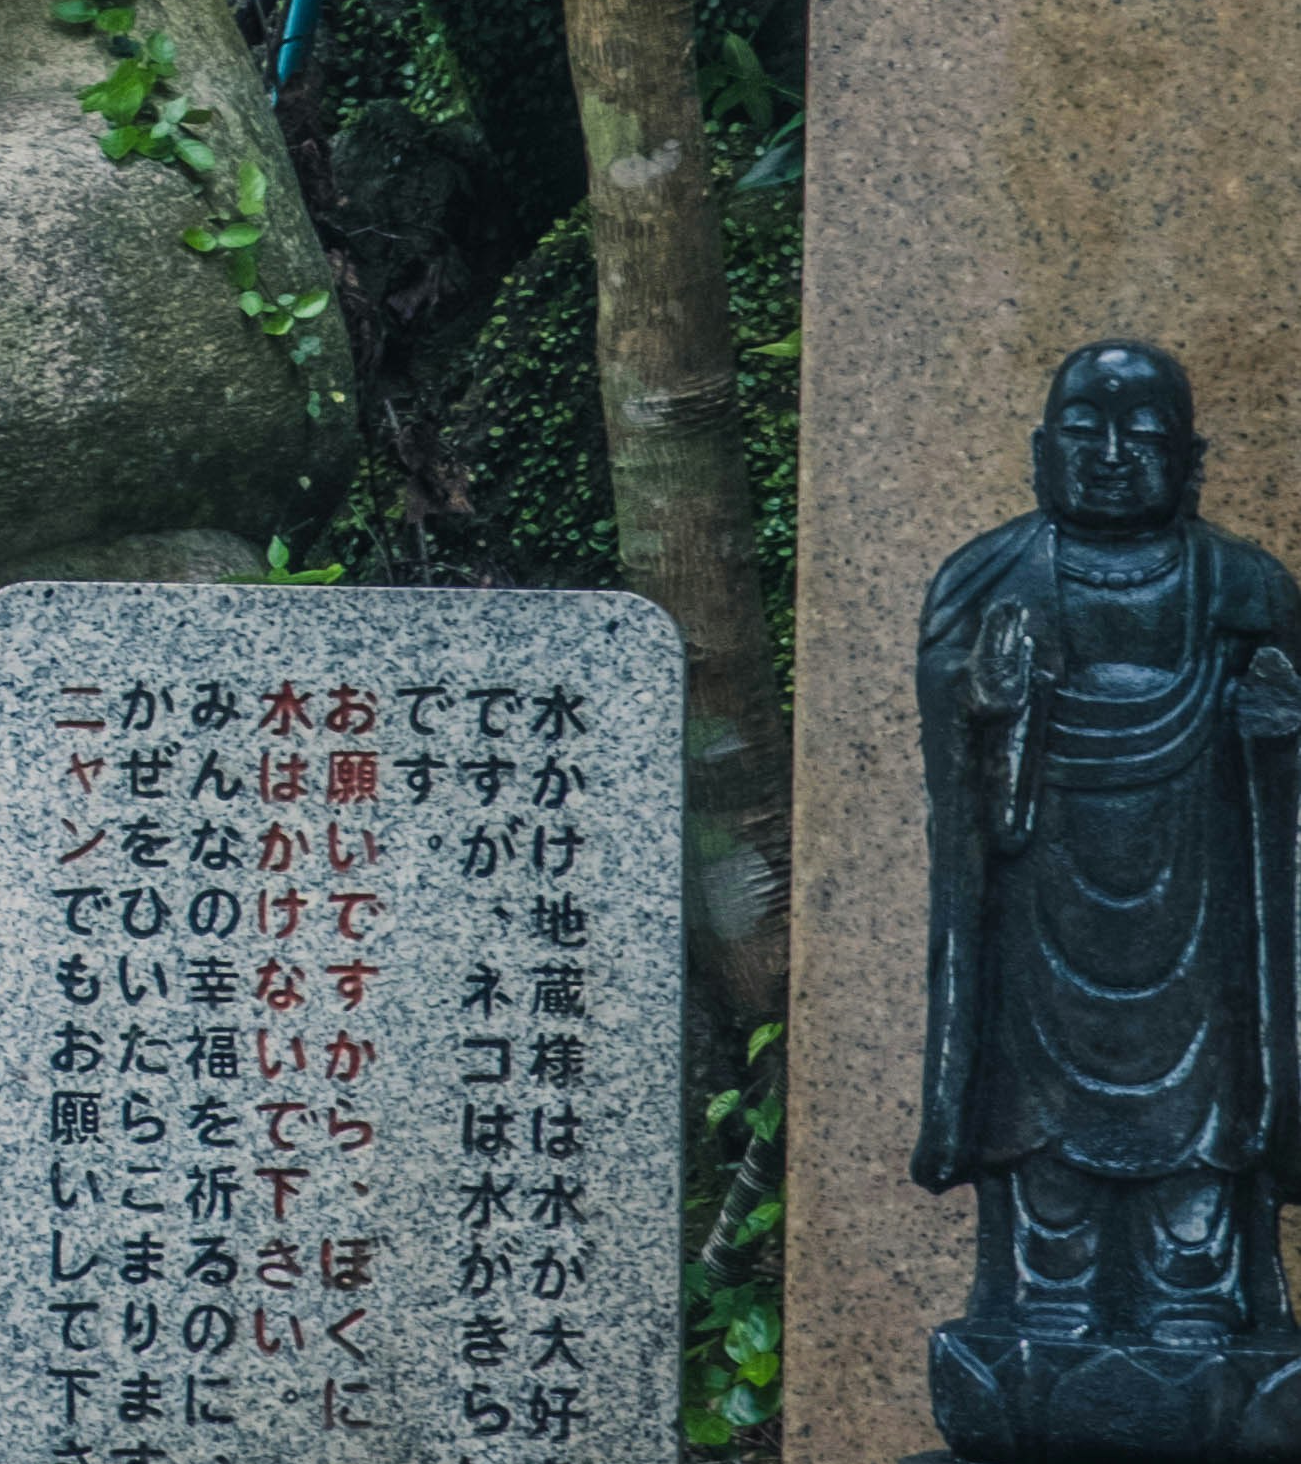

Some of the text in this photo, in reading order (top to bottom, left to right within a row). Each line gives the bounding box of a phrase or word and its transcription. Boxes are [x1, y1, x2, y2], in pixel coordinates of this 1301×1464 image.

[253, 680, 317, 1404] 水はかけないで下さい。
[321, 683, 387, 1430] お願いですから、ぼくに
[394, 685, 454, 851] です。
